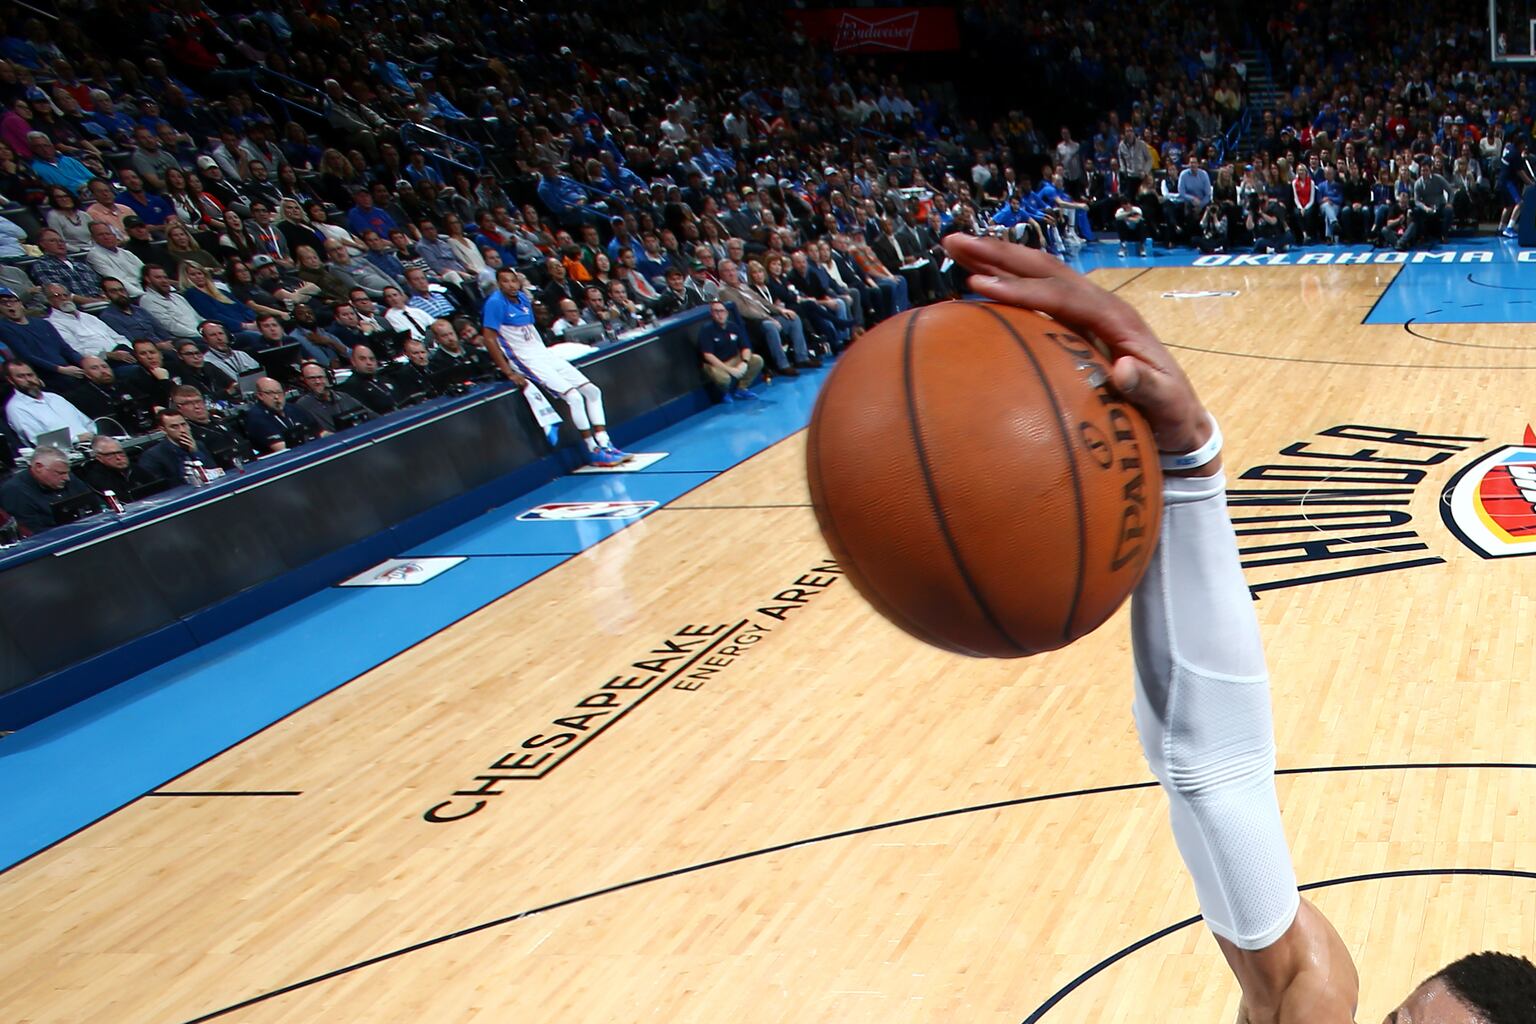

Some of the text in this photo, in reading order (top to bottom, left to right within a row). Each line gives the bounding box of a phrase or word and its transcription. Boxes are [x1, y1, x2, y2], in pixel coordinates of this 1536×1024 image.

[1192, 251, 1494, 266] OKLAHOMA
[673, 559, 845, 691] ENERGY AREN
[423, 624, 728, 824] CHESAPEAKE
